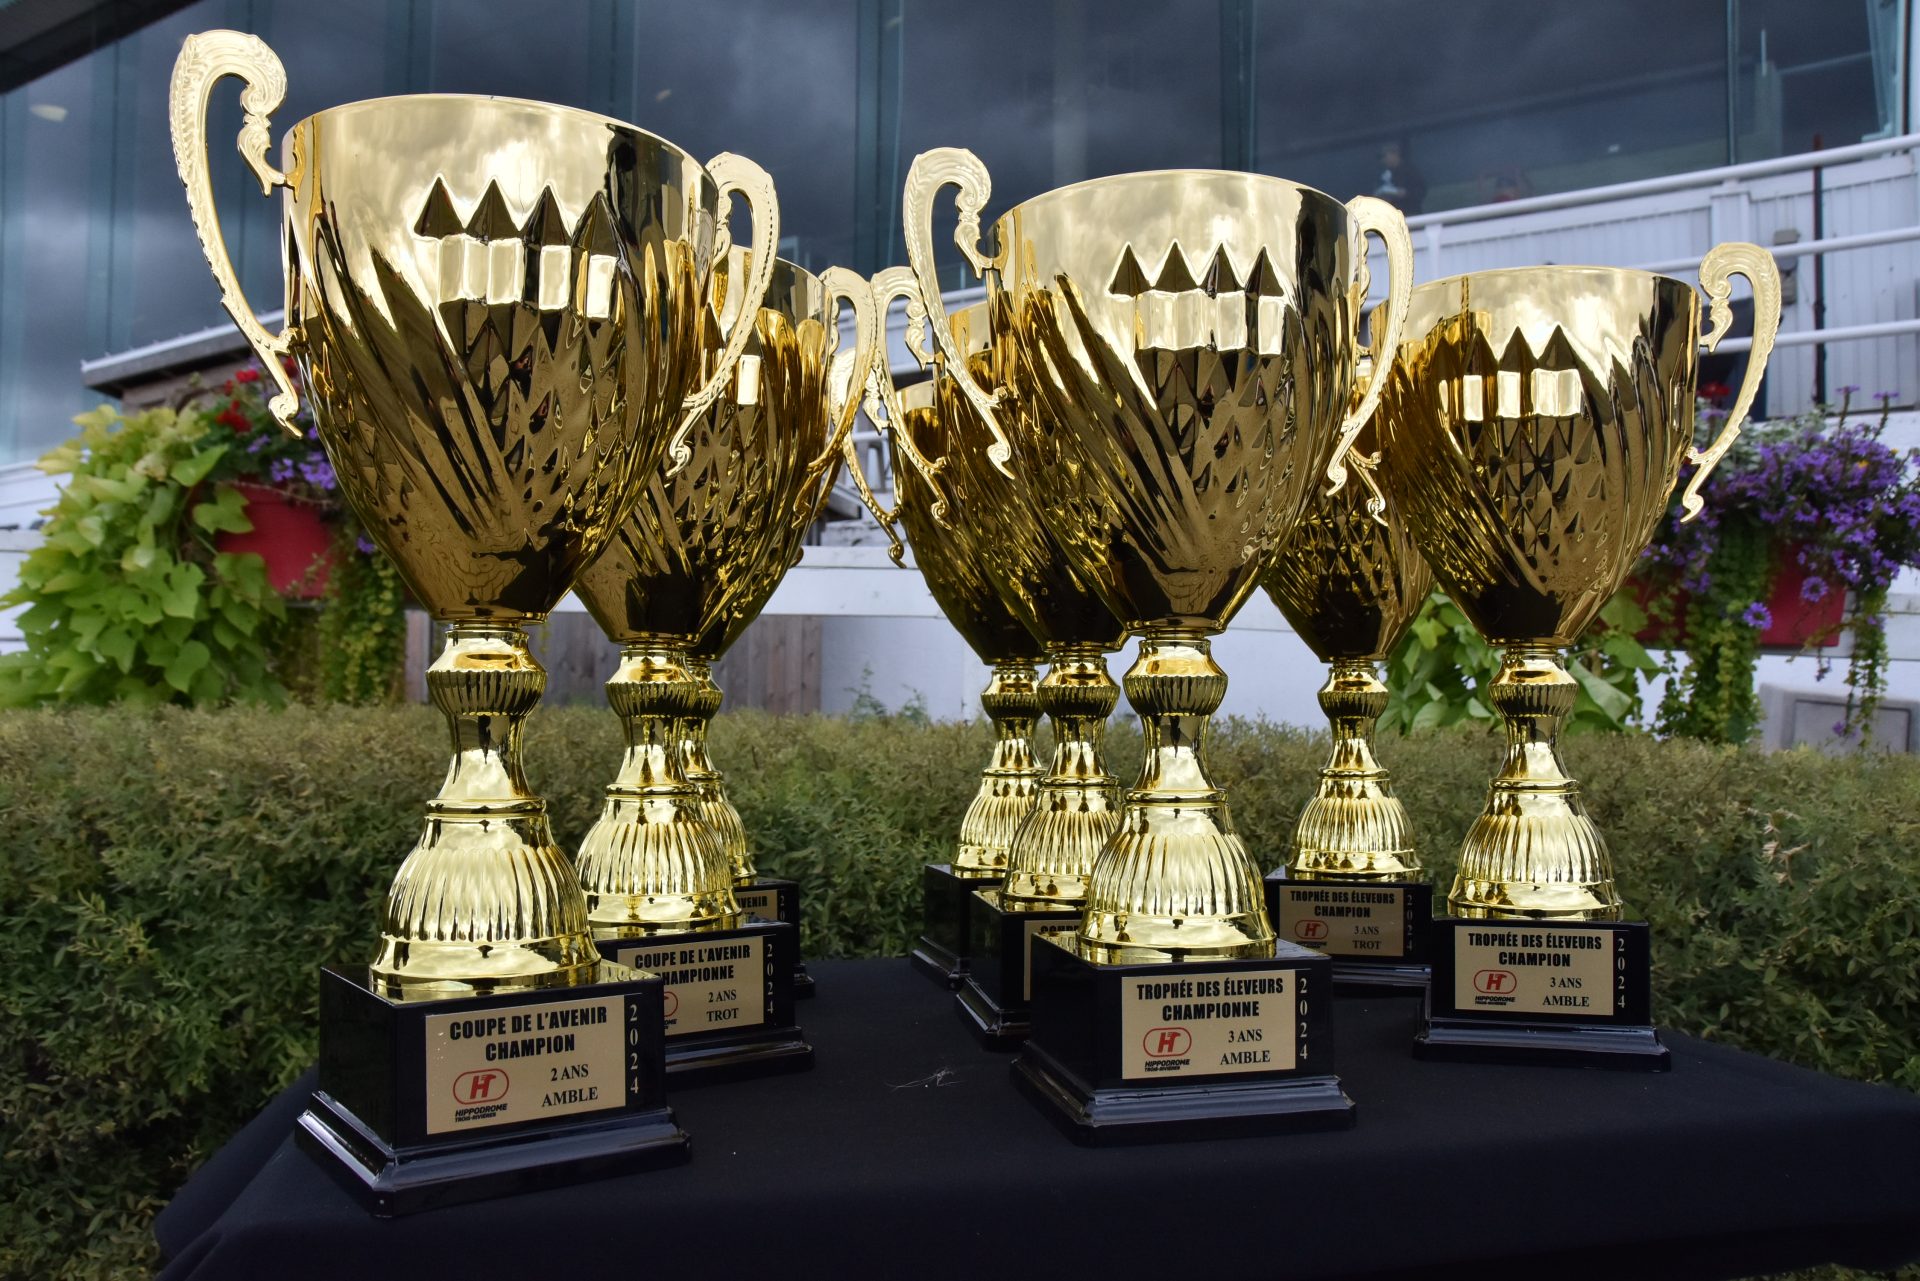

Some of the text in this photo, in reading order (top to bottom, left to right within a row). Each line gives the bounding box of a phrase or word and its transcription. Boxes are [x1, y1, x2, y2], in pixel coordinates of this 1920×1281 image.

[1290, 890, 1395, 904] TROPHÉE DES ÉLEVEURS
[1314, 905, 1371, 918] CHAMPION
[1354, 926, 1380, 935] 3 ANS
[1352, 940, 1381, 950] TROT
[1468, 932, 1602, 949] TROPHÉE DES ÉLEVEURS
[635, 944, 750, 969] COUPE DE L'AVENIR
[1499, 952, 1571, 967] CHAMPION
[1617, 938, 1626, 1008] 2024
[1137, 977, 1283, 1000] TROPHÉE DES ÉLEVEURS
[1550, 977, 1582, 988] 3 ANS
[708, 989, 737, 1003] 2 ANS
[1542, 996, 1590, 1007] AMBLE
[706, 1008, 739, 1022] TROT
[1162, 1001, 1259, 1021] CHAMPIONNE
[450, 1006, 607, 1041] COUPE DE L'AVENIR
[1300, 978, 1308, 1060] 2024
[1228, 1029, 1263, 1043] 3 ANS
[485, 1034, 575, 1061] CHAMPION
[630, 1004, 639, 1094] 2024
[1145, 1059, 1190, 1067] HIPPODROME
[1220, 1050, 1271, 1065] AMBLE
[551, 1064, 589, 1081] 2 ANS
[542, 1087, 598, 1107] AMBLE
[455, 1103, 508, 1116] HIPPODROME
